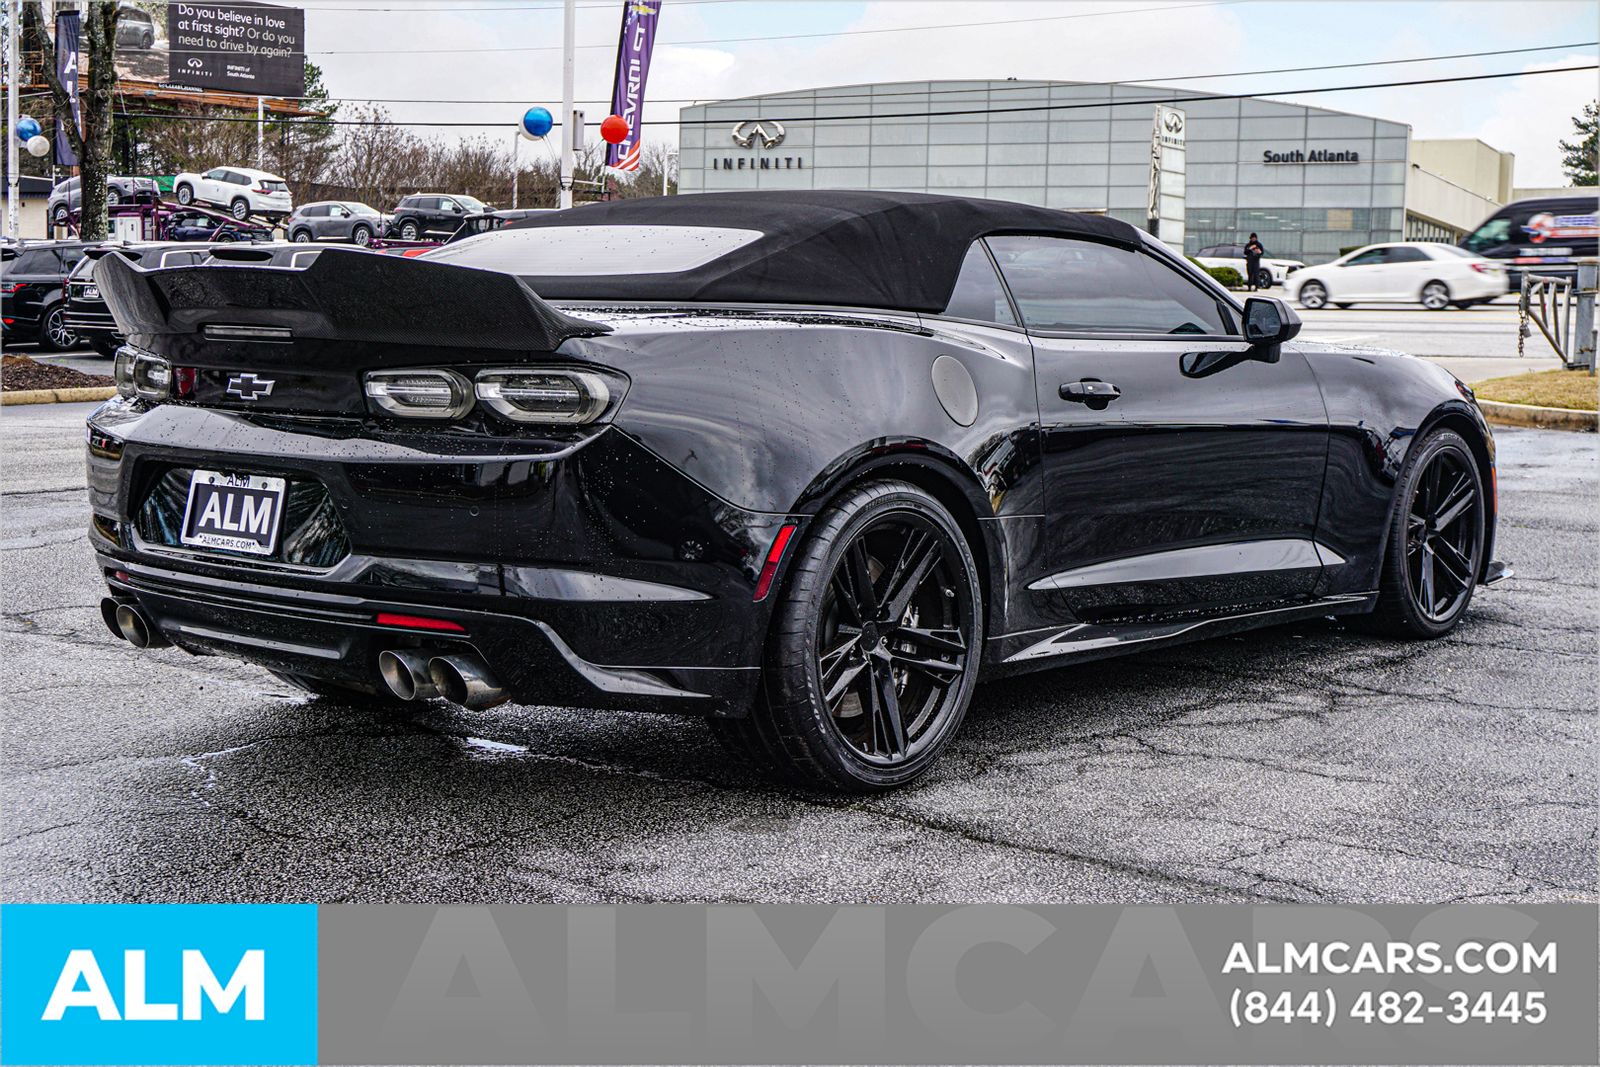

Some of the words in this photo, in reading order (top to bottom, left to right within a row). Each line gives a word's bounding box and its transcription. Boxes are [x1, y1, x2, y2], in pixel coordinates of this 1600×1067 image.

[178, 3, 194, 15] Do
[196, 9, 215, 19] you
[217, 9, 252, 24] believe
[254, 14, 263, 25] in
[265, 16, 286, 29] love
[178, 20, 190, 30] at
[191, 20, 212, 33] first
[215, 25, 244, 38] sight?
[247, 28, 261, 39] Or
[262, 30, 275, 41] do
[277, 34, 295, 45] you
[178, 34, 204, 46] need
[206, 37, 218, 48] to
[219, 39, 245, 53] drive
[246, 42, 259, 56] by
[260, 45, 292, 58] again?
[178, 68, 212, 77] INFINITI
[713, 157, 802, 170] INFINITI
[1263, 149, 1304, 163] South
[1307, 149, 1359, 163] Atlanta
[226, 473, 250, 487] ALM
[198, 491, 272, 535] ALM
